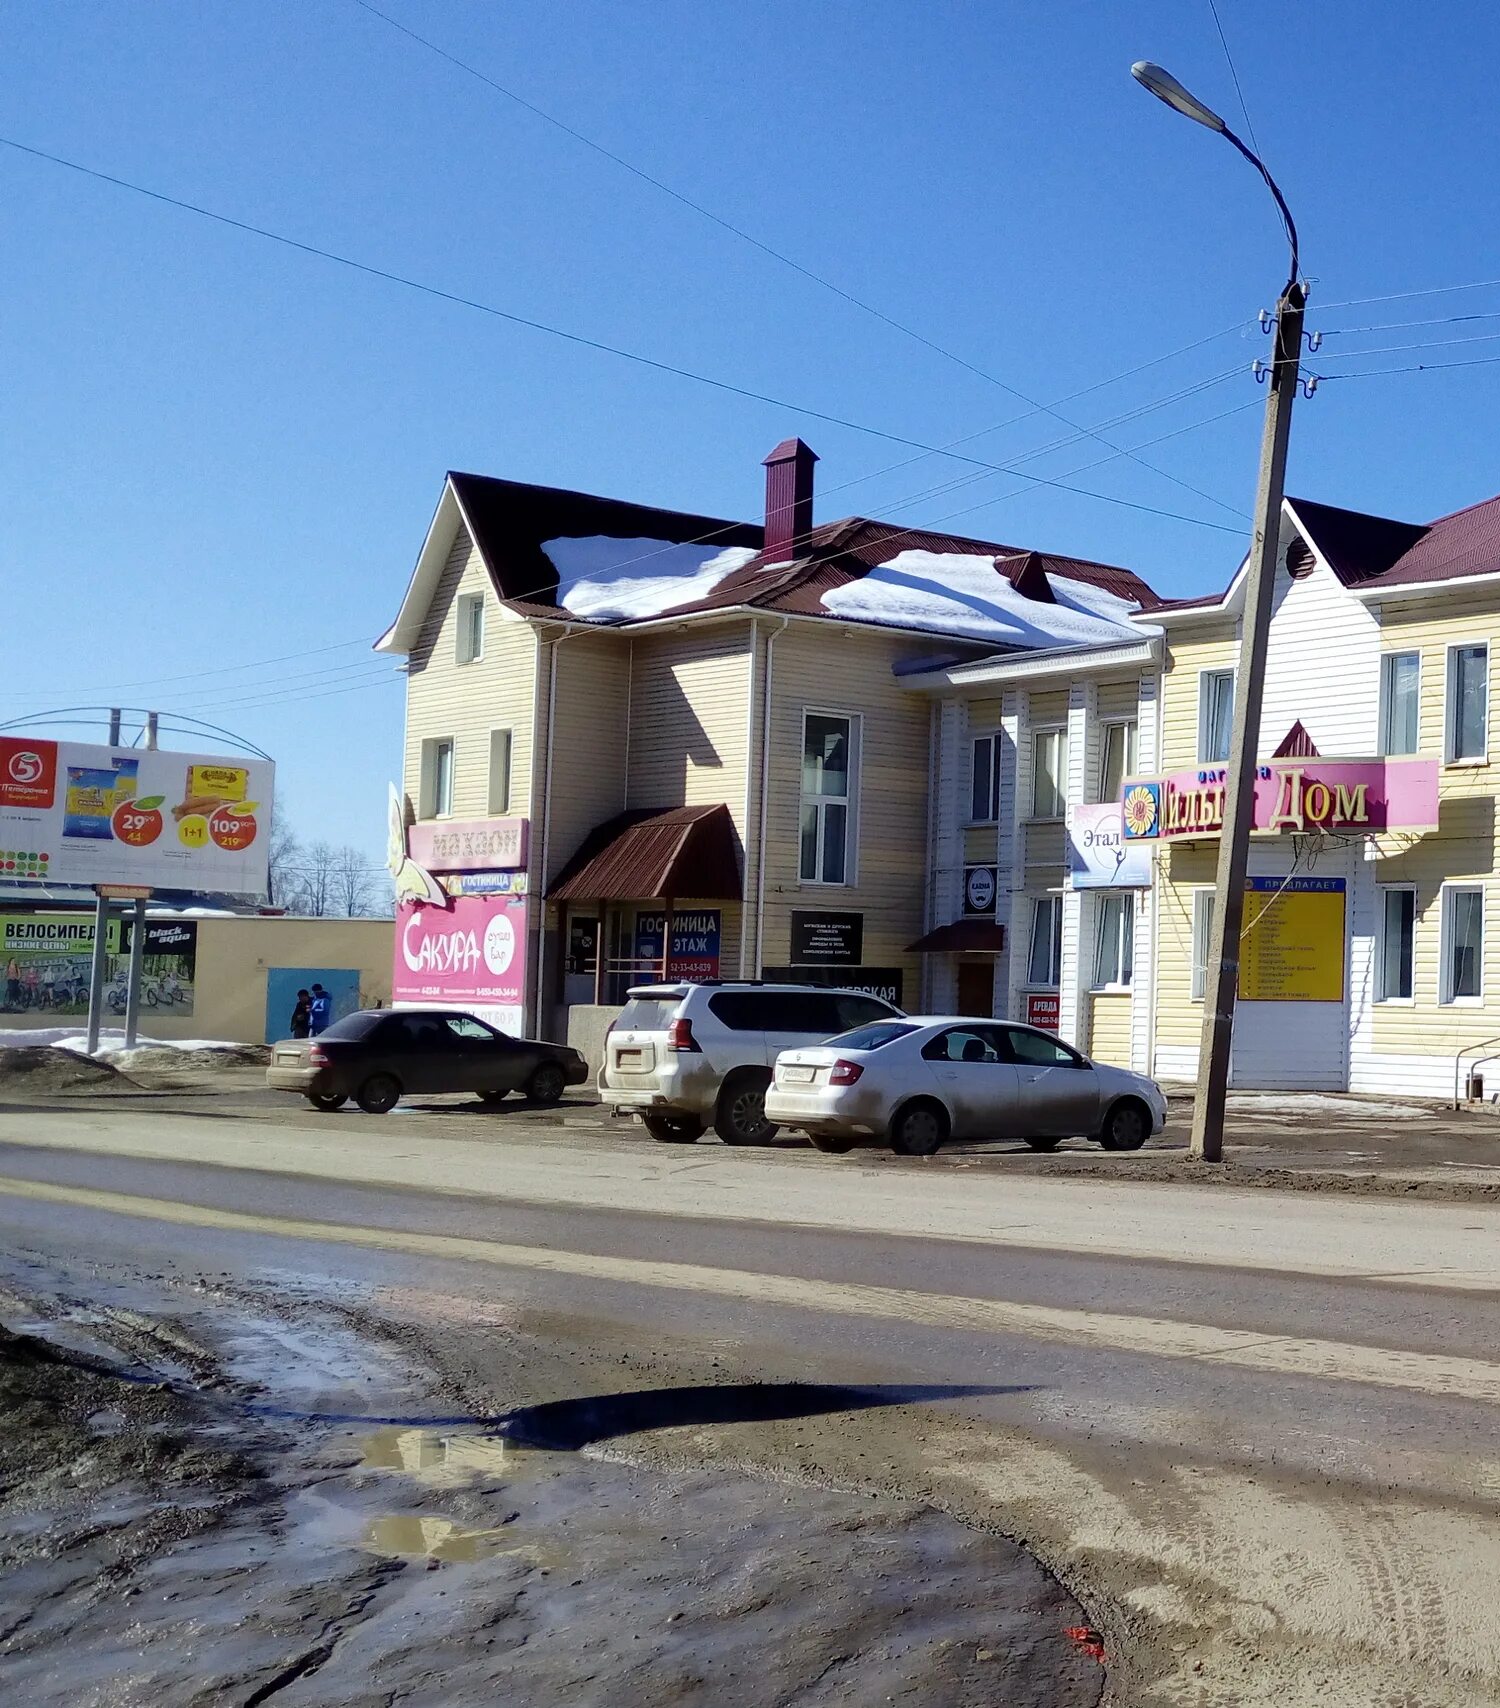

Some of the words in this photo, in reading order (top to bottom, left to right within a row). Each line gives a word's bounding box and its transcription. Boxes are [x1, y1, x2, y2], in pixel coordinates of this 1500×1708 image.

[184, 827, 203, 838] 1+1
[212, 819, 240, 834] 109
[1083, 829, 1121, 847] Этал
[462, 872, 510, 887] ГОСТИНИЦА
[149, 926, 183, 939] black
[639, 916, 717, 934] ГОСИНИЦА
[158, 932, 191, 944] aqua
[673, 938, 708, 953] ЭТАЖ
[1033, 1001, 1058, 1012] АРЕНДА
